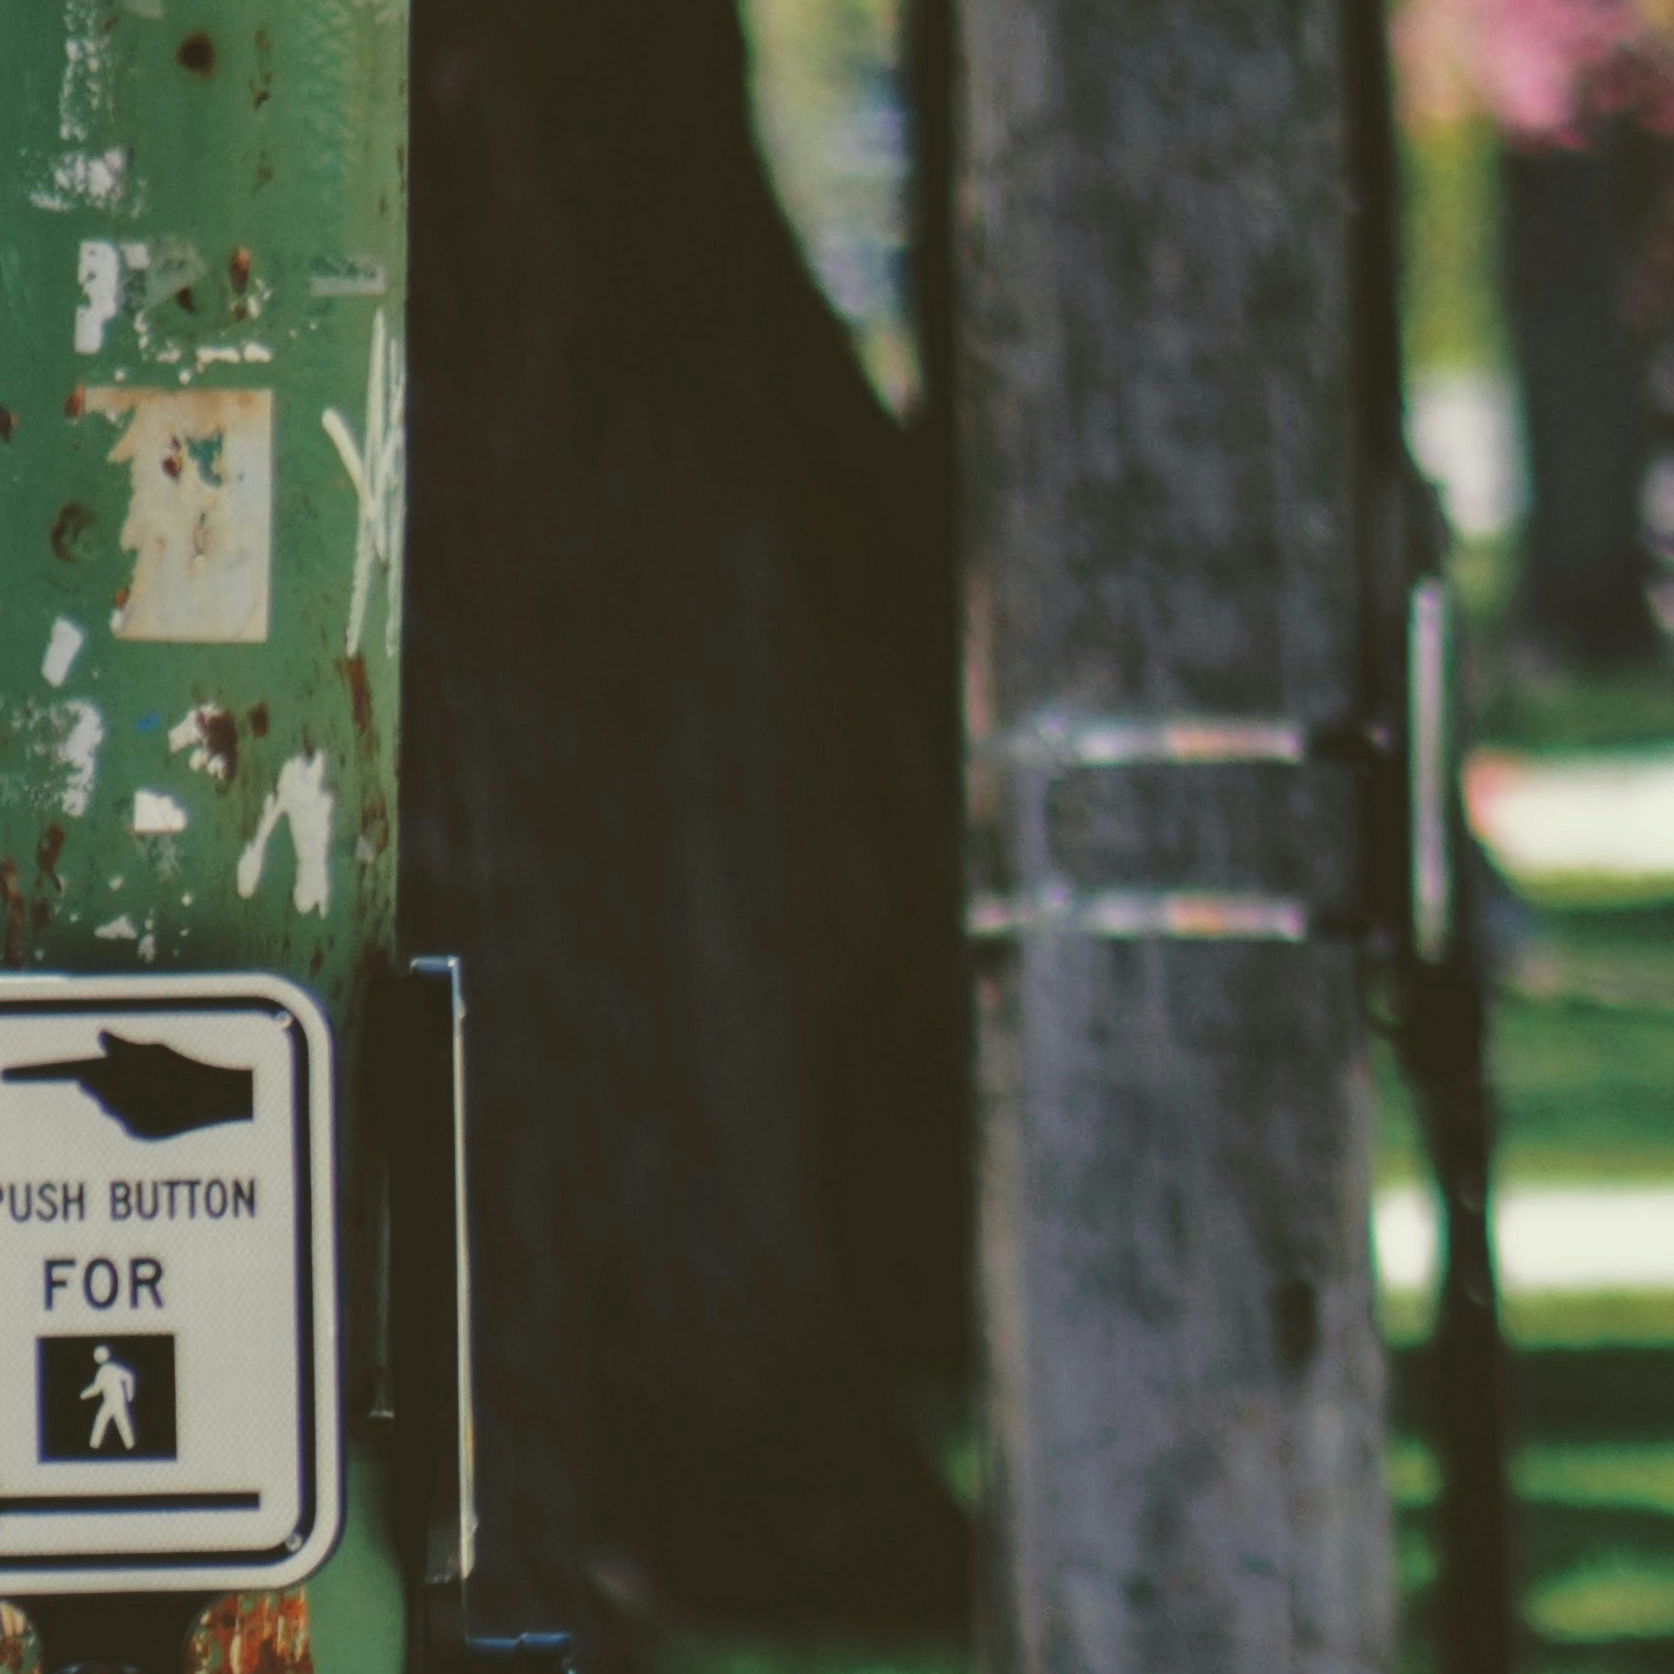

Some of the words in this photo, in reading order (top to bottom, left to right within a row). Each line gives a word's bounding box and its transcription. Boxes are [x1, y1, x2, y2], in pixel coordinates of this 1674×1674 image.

[0, 1182, 85, 1223] USH
[110, 1178, 257, 1221] BUTTON
[43, 1257, 164, 1311] FOR
